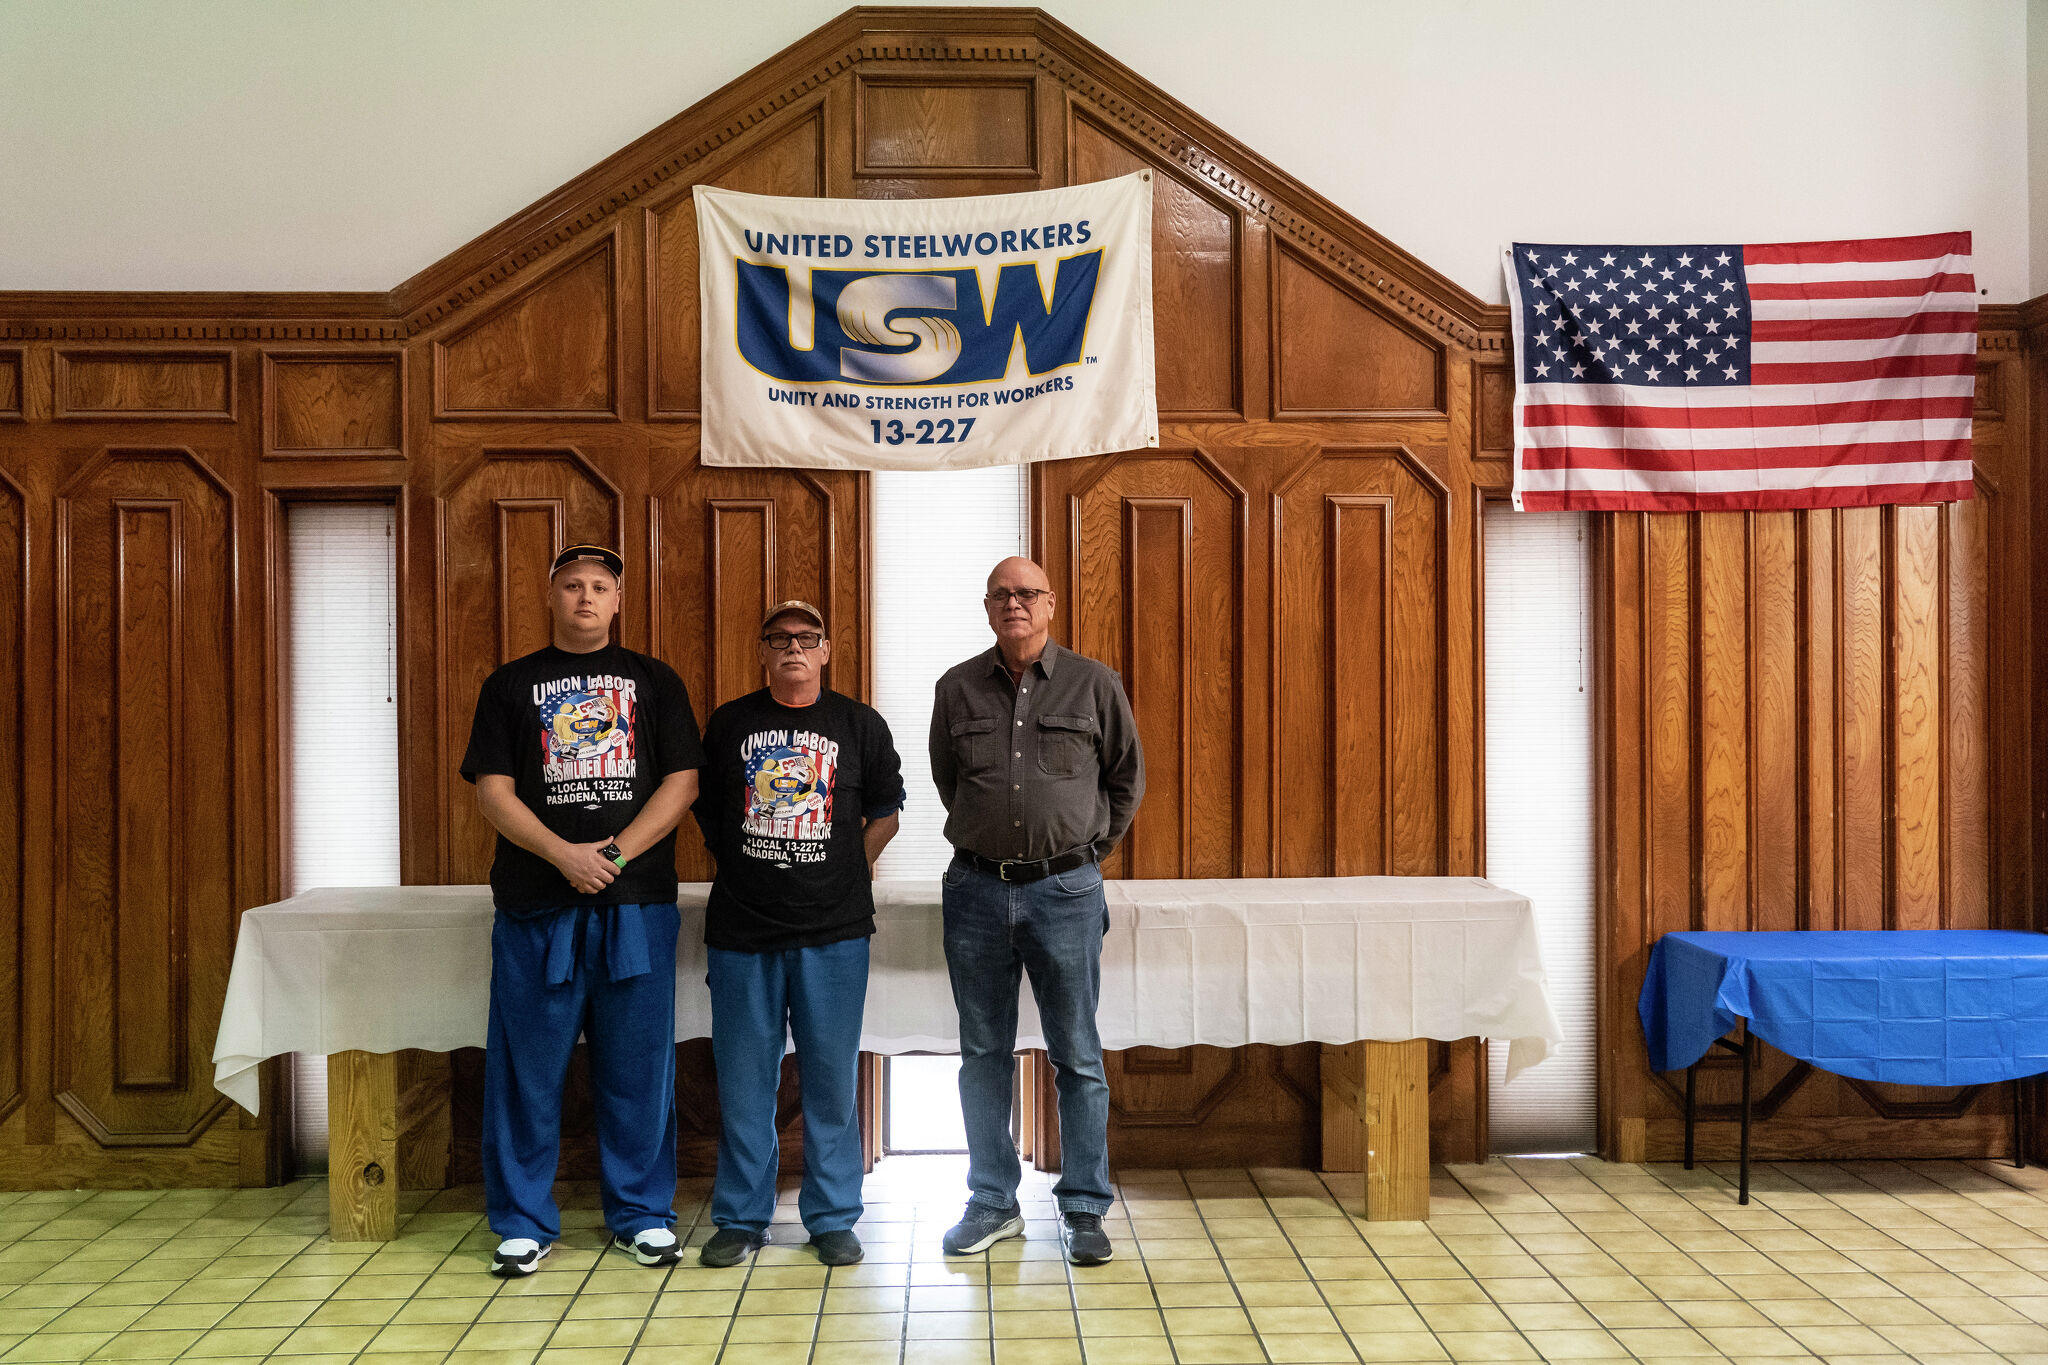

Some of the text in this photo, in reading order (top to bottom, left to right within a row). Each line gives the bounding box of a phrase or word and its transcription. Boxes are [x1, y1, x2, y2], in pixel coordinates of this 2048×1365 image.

[744, 220, 1092, 258] UNITED STEELWORKERS
[735, 246, 1104, 387] USW
[1085, 356, 1098, 365] TM
[768, 375, 1074, 410] UNITY AND STRENGTH FOR WORKERS
[870, 417, 976, 445] 13-227
[533, 675, 637, 706] UNION LABOR
[741, 730, 839, 769] UNION LABOR
[605, 758, 636, 778] LABOR
[546, 791, 633, 805] PASADENA, TEXAS
[557, 780, 624, 793] LOCAL 13-227
[742, 844, 826, 863] PASADENA, TEXAS
[752, 838, 817, 852] LOCAL 13-227
